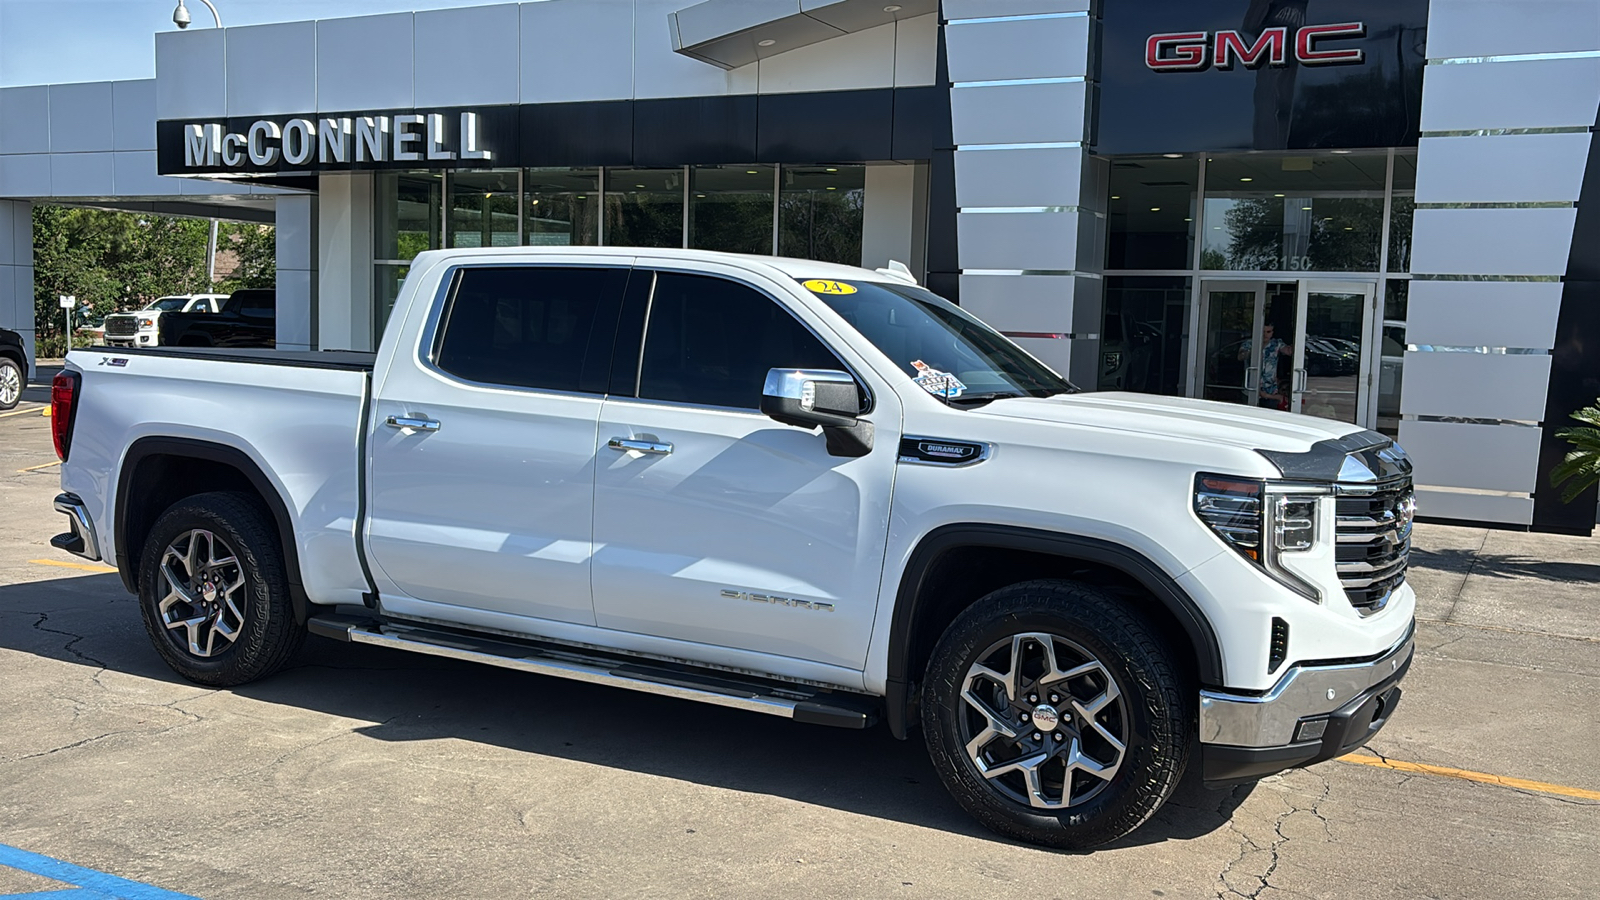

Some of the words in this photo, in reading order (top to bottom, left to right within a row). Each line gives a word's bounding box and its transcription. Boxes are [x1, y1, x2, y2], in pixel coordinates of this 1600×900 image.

[1145, 22, 1363, 70] GMC
[184, 112, 491, 167] McCONNELL
[1269, 255, 1311, 271] 3150
[817, 281, 842, 293] 24
[927, 444, 964, 454] DURAMAX
[720, 589, 835, 612] SIERRA
[1034, 713, 1057, 723] GMC
